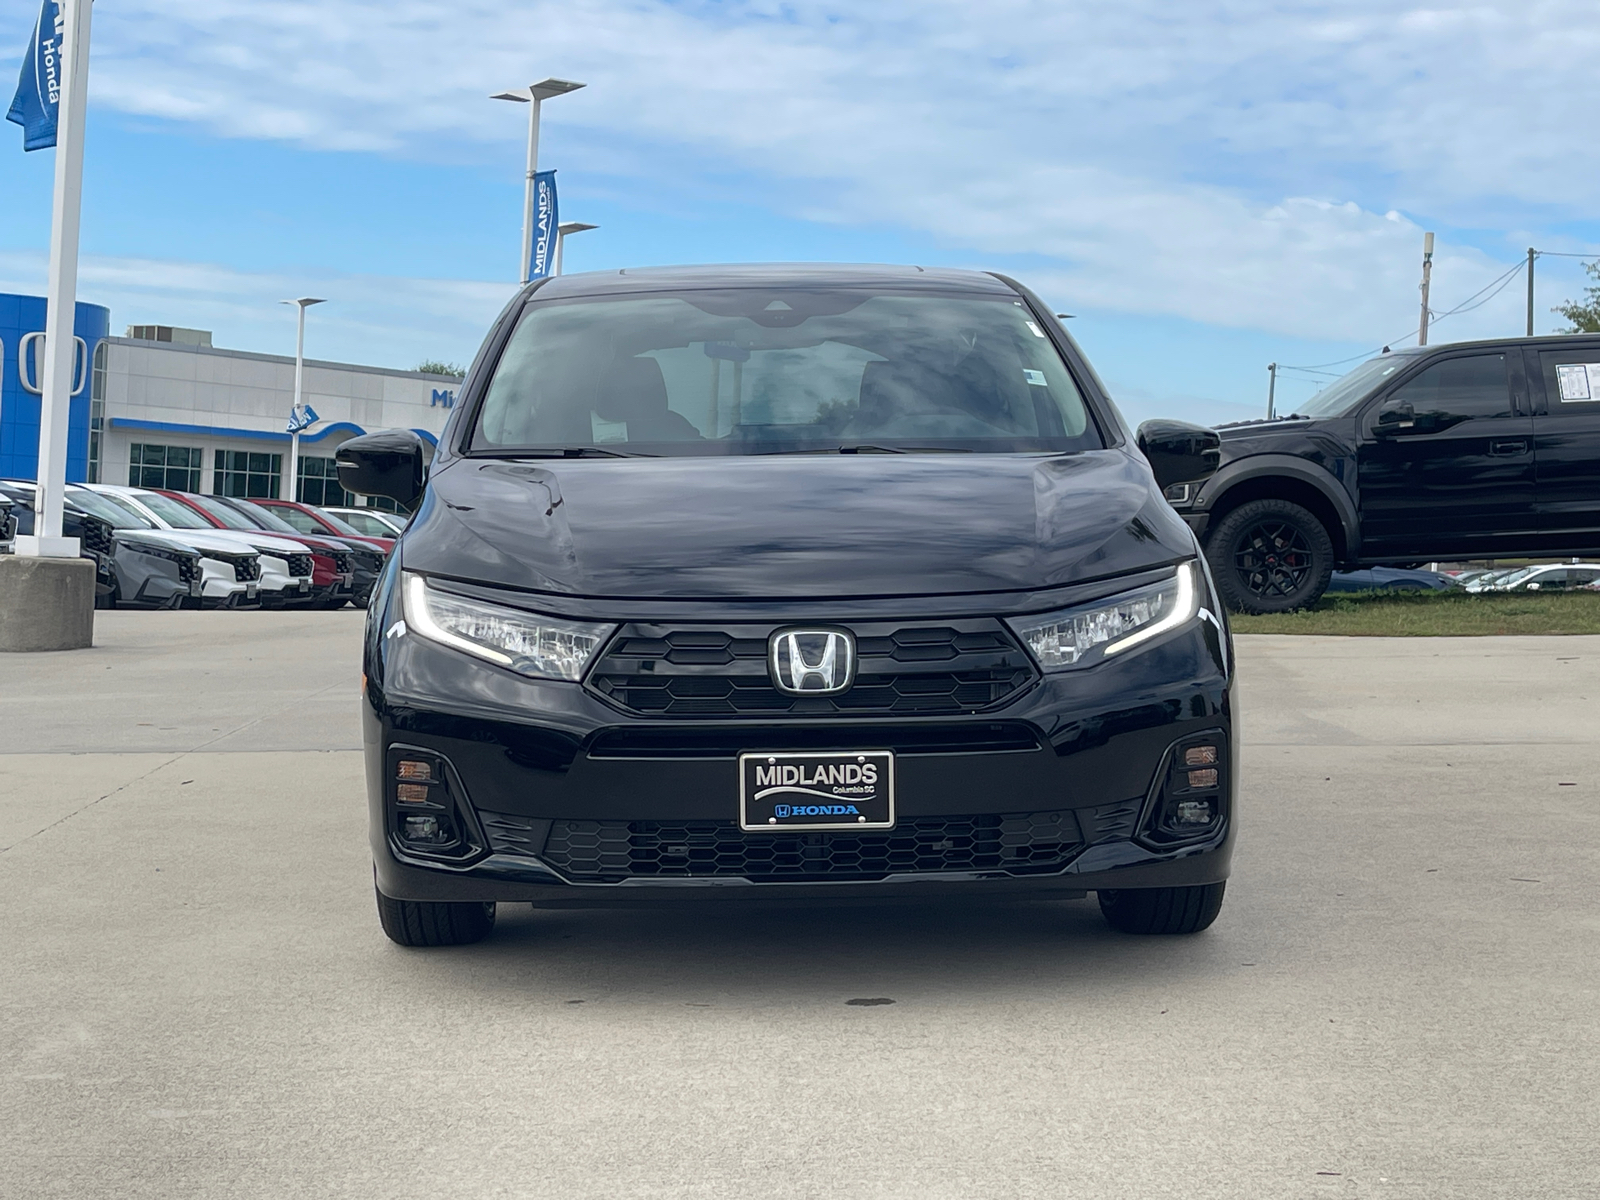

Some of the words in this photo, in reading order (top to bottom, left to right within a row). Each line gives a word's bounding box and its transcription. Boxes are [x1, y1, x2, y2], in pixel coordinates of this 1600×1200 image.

[43, 38, 61, 104] Honda
[534, 180, 548, 274] MIDLANDS
[432, 388, 457, 408] Mi
[756, 763, 878, 786] MIDLANDS
[832, 785, 864, 794] Columbia
[864, 785, 875, 793] SC
[791, 804, 860, 816] HONDA
